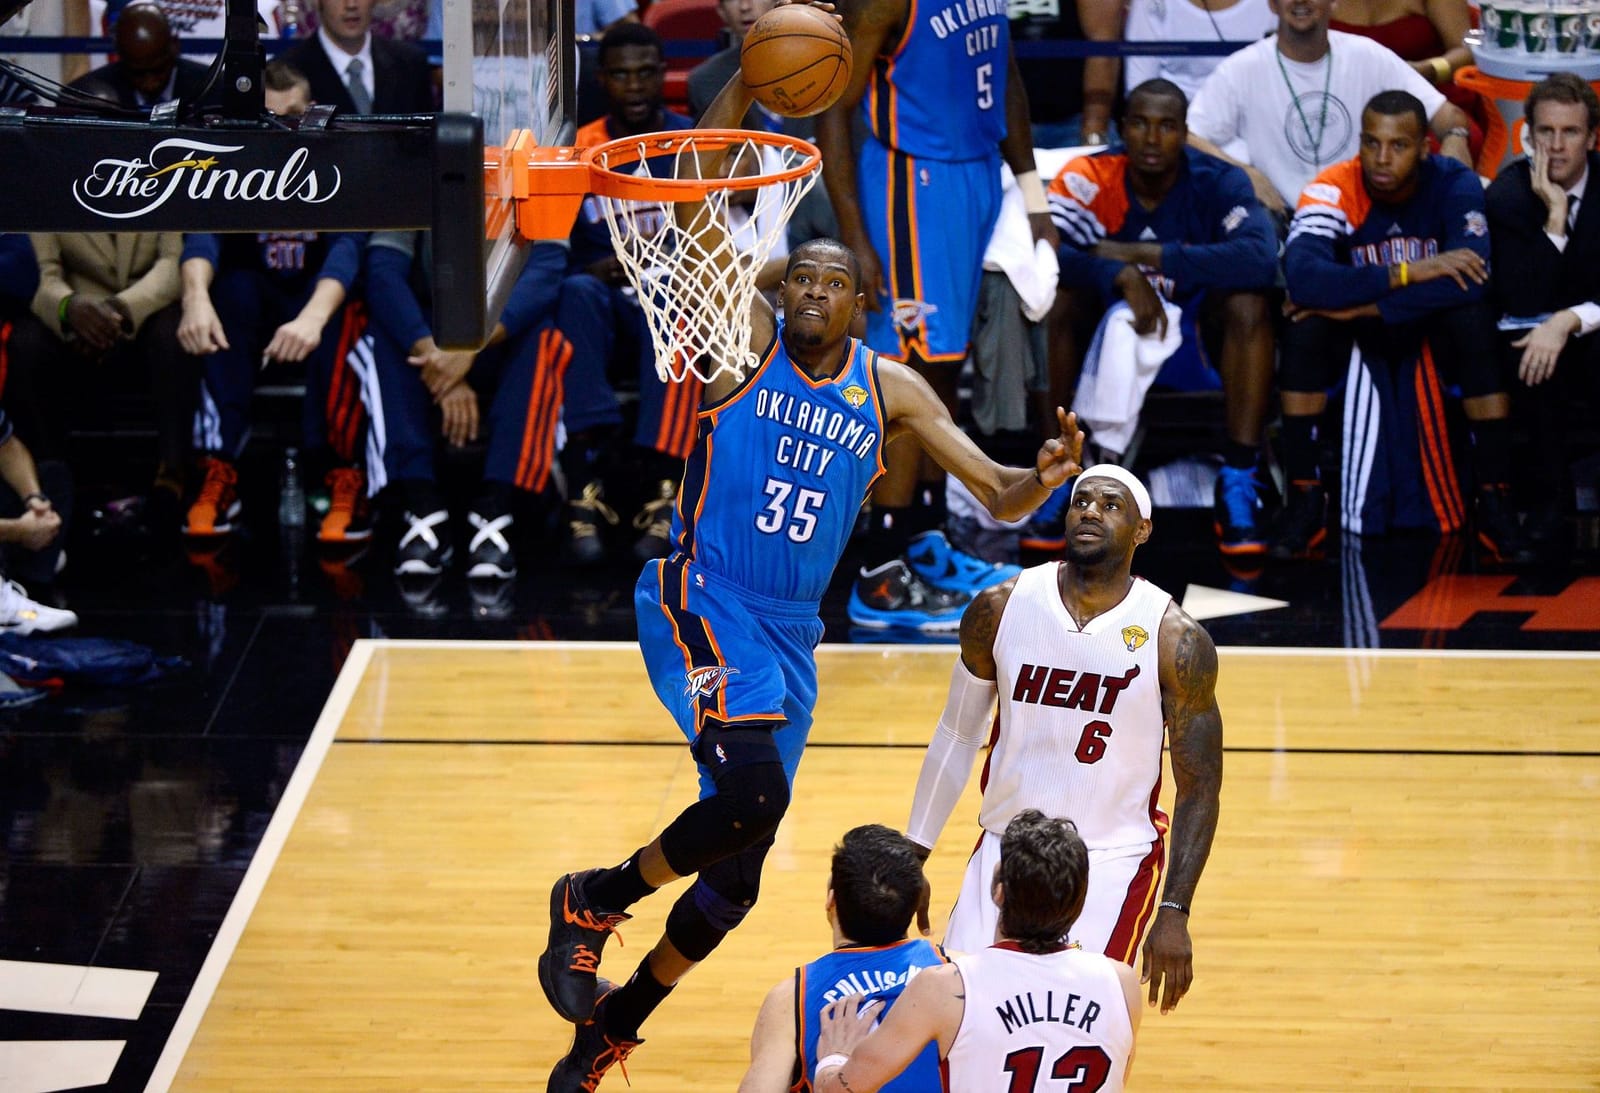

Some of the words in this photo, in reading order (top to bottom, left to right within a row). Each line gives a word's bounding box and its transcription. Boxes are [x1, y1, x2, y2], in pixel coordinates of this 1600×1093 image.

[965, 24, 999, 57] CITY
[976, 62, 994, 110] 5
[73, 138, 341, 219] Finals
[84, 157, 159, 199] The
[755, 388, 877, 460] OKLAHOMA
[776, 434, 836, 477] CITY
[755, 477, 826, 544] 35
[1012, 663, 1141, 715] HEAT
[1074, 719, 1113, 765] 6
[995, 990, 1102, 1035] MILLER
[1003, 1045, 1112, 1093] 13
